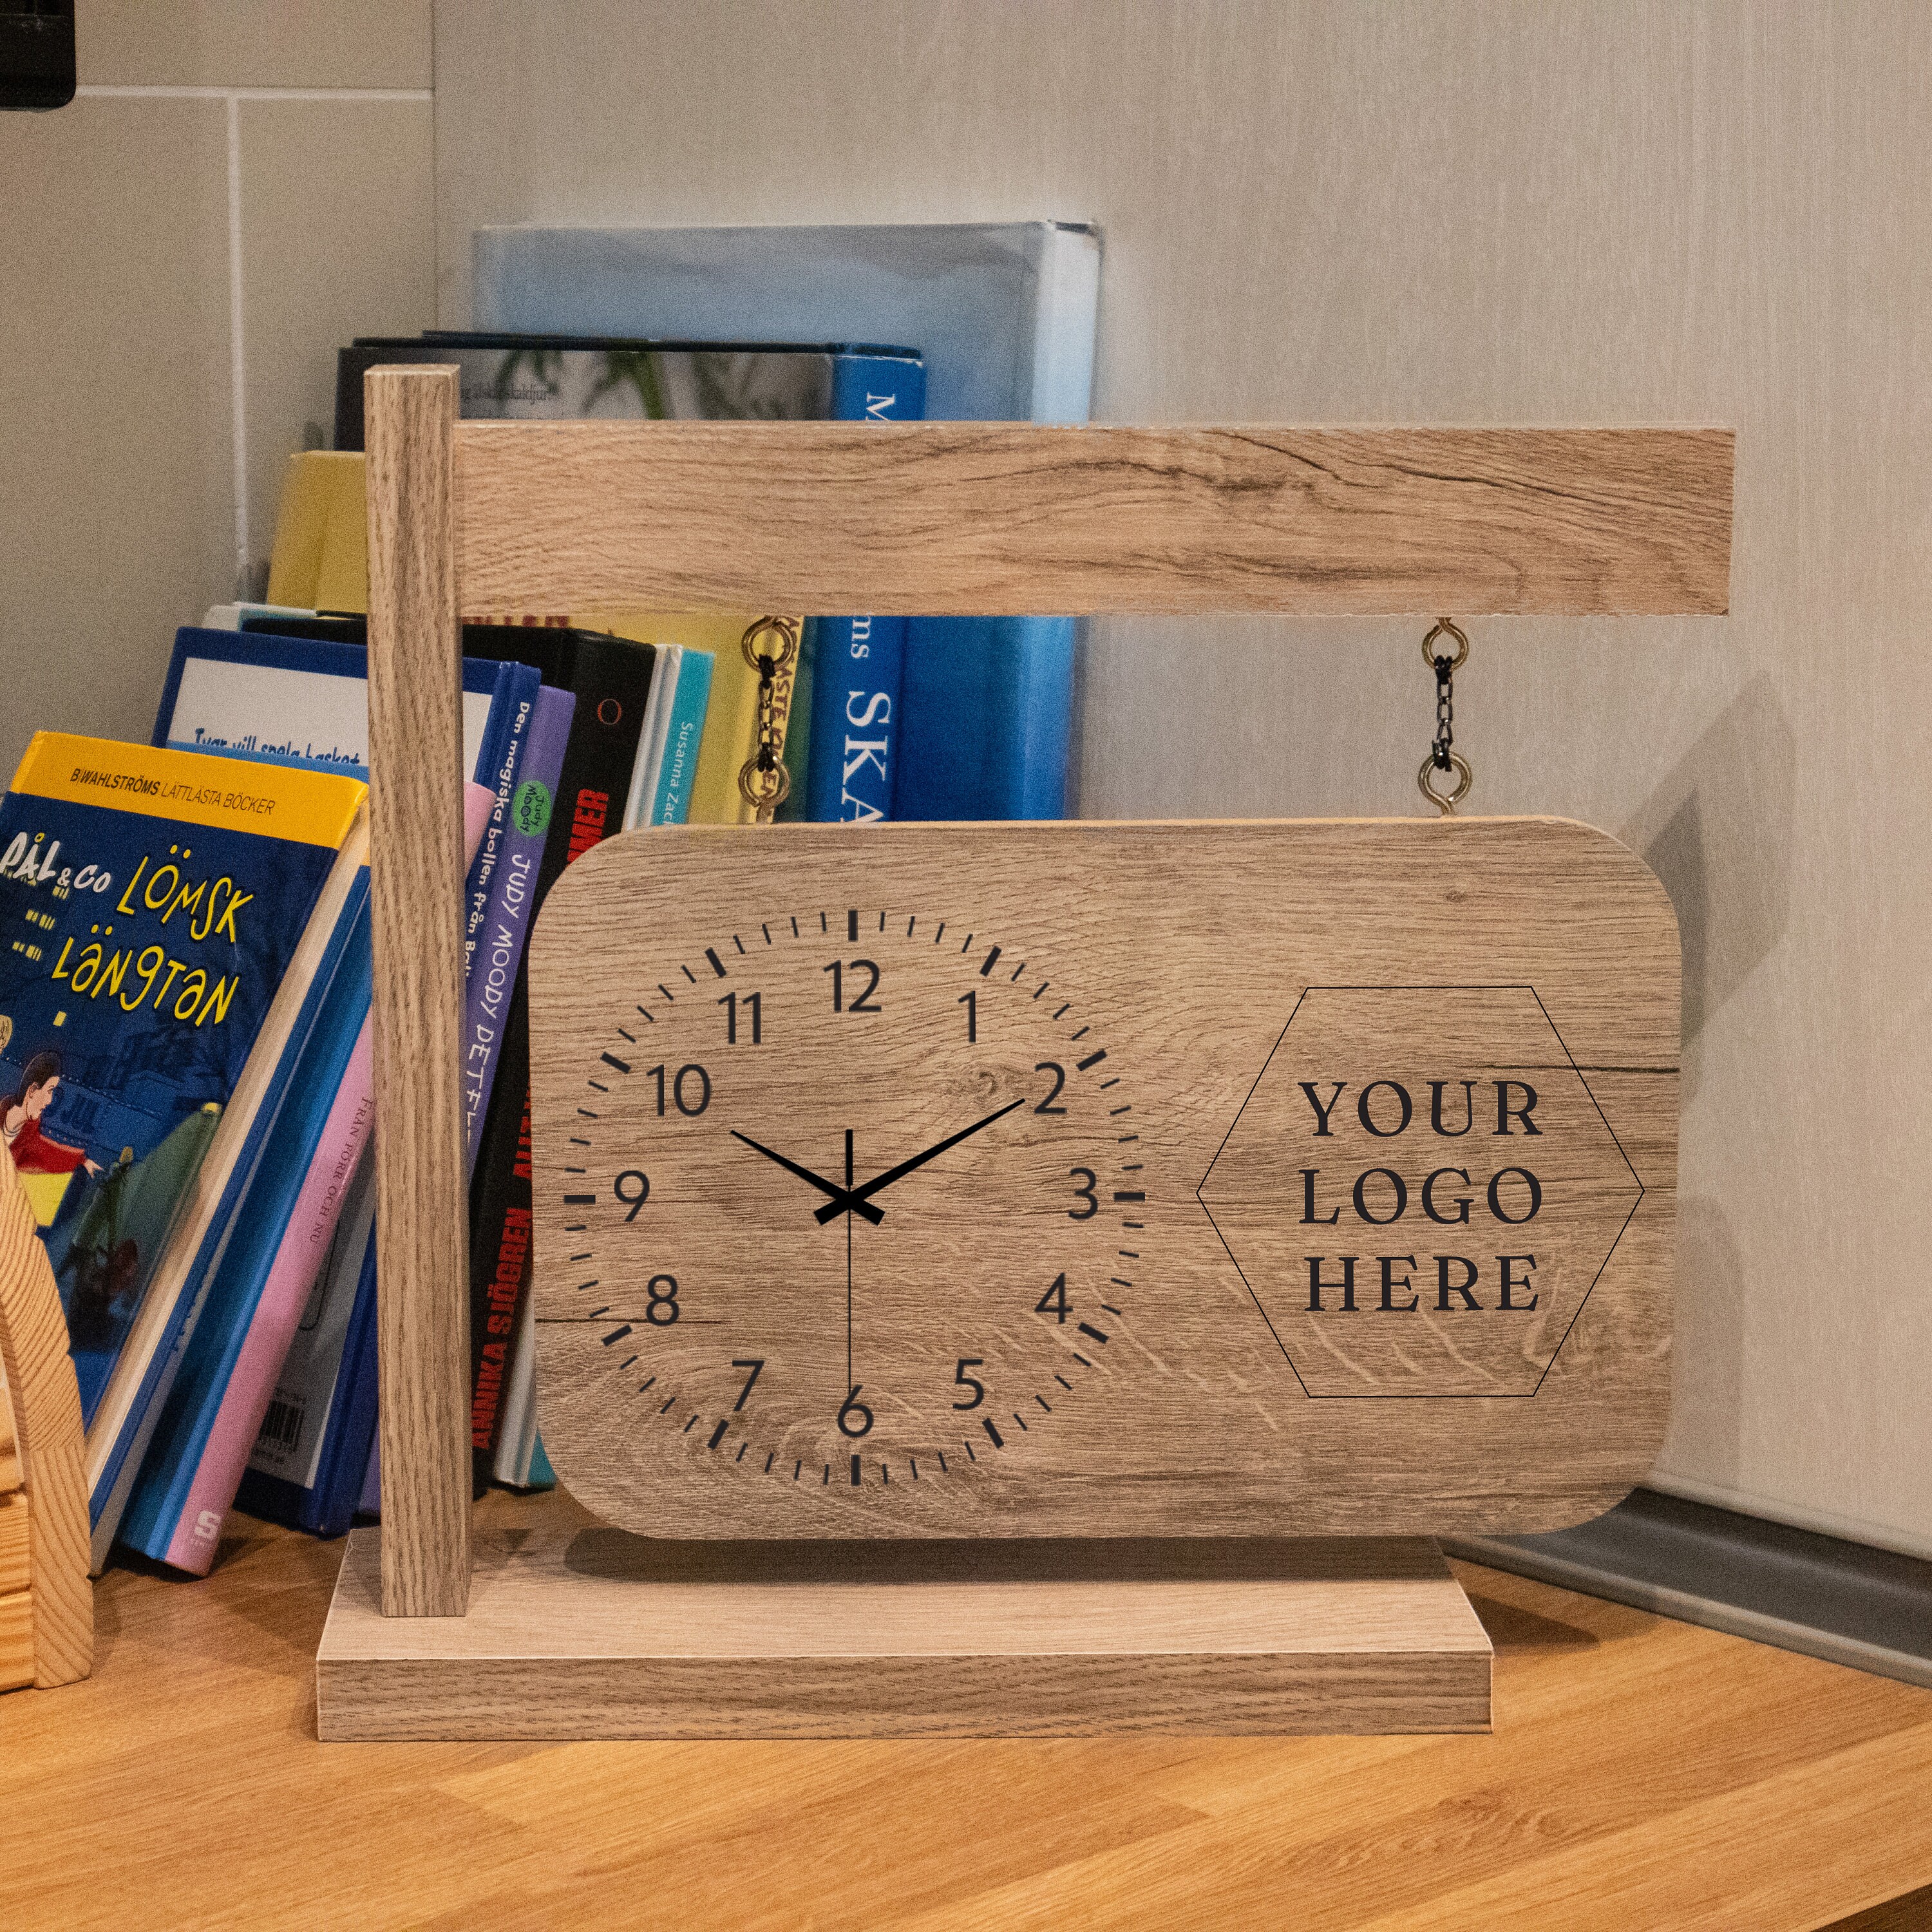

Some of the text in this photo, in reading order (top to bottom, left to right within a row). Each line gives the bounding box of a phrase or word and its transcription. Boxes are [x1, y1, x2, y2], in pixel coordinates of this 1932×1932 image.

[514, 701, 530, 734] Den
[493, 740, 518, 822] magiska
[669, 721, 693, 788] Susanna
[161, 781, 221, 805] LÄTTLÄSTA
[223, 791, 276, 815] BÖCKER
[0, 832, 60, 882] PÅL
[478, 828, 502, 886] bollen
[116, 844, 254, 943] LÖMSK
[468, 892, 491, 934] från
[502, 854, 531, 919] JUDY
[480, 923, 513, 1019] MOODY
[823, 960, 882, 1013] 12
[718, 991, 762, 1045] 11
[958, 990, 977, 1043] 1
[646, 1064, 712, 1117] 10
[1034, 1063, 1067, 1115] 2
[1297, 1080, 1543, 1137] YOUR
[333, 1142, 354, 1180] FÖRR
[319, 1185, 338, 1217] OCH
[612, 1170, 650, 1223] 9
[1068, 1168, 1099, 1220] 3
[1298, 1167, 1542, 1224] LOGO
[310, 1223, 324, 1244] NU
[487, 1208, 533, 1334] SJÖGREN
[1303, 1255, 1539, 1312] HERE
[645, 1274, 679, 1327] 8
[1034, 1273, 1074, 1325] 4
[472, 1343, 507, 1450] ANNIKA
[732, 1359, 765, 1412] 7
[952, 1359, 985, 1410] 5
[837, 1385, 875, 1438] 6
